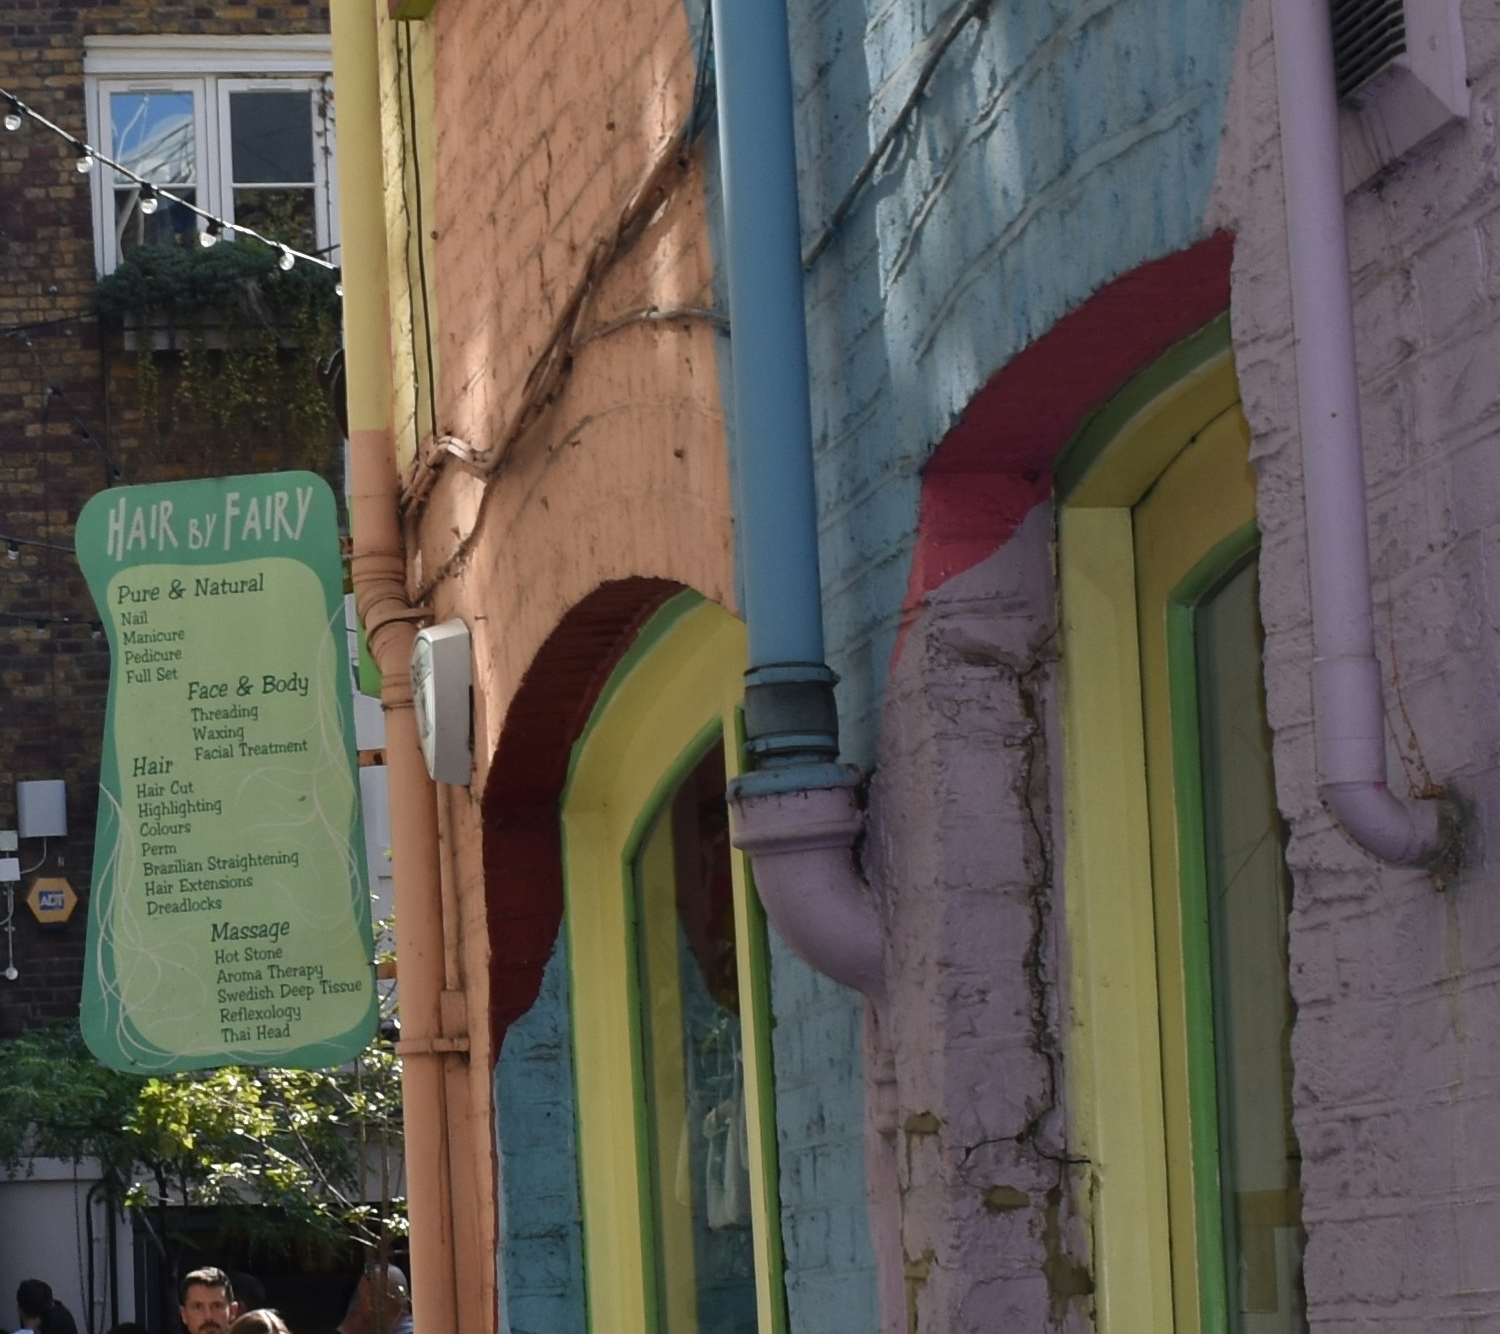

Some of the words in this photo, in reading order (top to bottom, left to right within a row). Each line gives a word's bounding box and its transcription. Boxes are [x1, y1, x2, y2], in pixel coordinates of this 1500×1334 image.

[106, 496, 180, 562] HAIR
[223, 486, 314, 552] FAIRY
[116, 583, 160, 605] Pure
[168, 579, 187, 600] &
[194, 573, 265, 598] Natural
[120, 611, 149, 627] Nail
[122, 628, 186, 646] Manicure
[124, 648, 183, 665] Pedicure
[126, 669, 152, 684] Full
[156, 667, 179, 682] Set
[187, 680, 229, 701] Face
[236, 676, 255, 697] &
[262, 672, 310, 697] Body
[190, 705, 259, 723] Threading
[192, 725, 245, 742] Waxing
[194, 745, 235, 761] Facial
[238, 739, 308, 758] Treatment
[132, 756, 174, 777] Hair
[136, 783, 166, 799] Hair
[170, 781, 195, 796] Cut
[137, 799, 223, 820] Highlighting
[139, 821, 192, 837] Colours
[141, 841, 178, 857] Perm
[143, 859, 203, 877] Brazilian
[207, 850, 300, 872] Straightening
[145, 881, 174, 897] Hair
[179, 875, 254, 893] Extensions
[39, 892, 65, 909] ADT
[146, 897, 223, 917] Dreadlocks
[210, 920, 291, 943] Massage
[214, 950, 240, 965] Hot
[244, 946, 283, 962] Stone
[216, 969, 263, 985] Aroma
[267, 964, 324, 981] Therapy
[216, 985, 275, 1004] Swedish
[279, 983, 315, 1000] Deep
[319, 978, 363, 995] Tissue
[220, 1004, 302, 1024] Reflexology
[220, 1027, 253, 1043] Thai
[256, 1023, 292, 1040] Head
